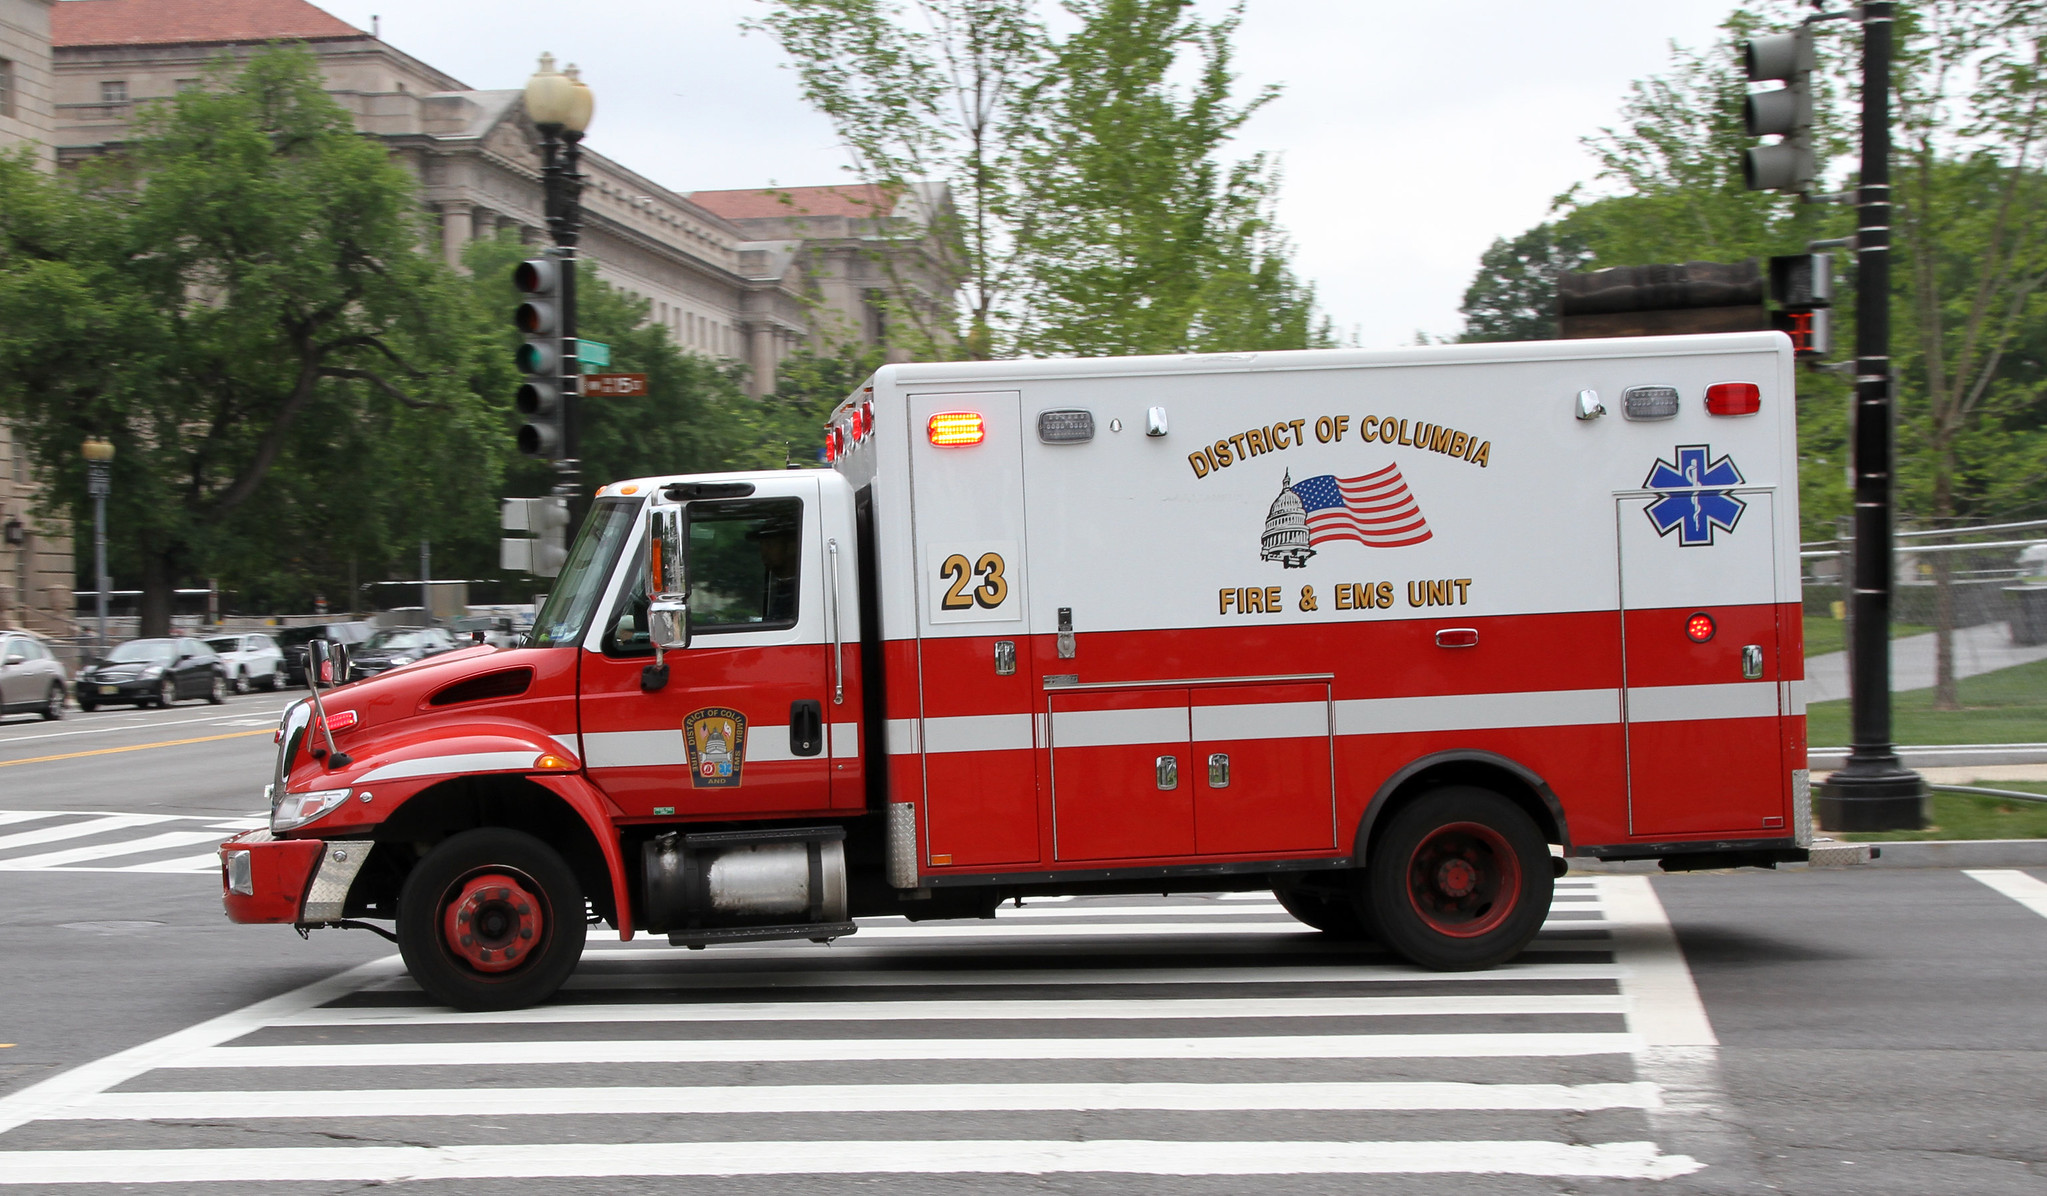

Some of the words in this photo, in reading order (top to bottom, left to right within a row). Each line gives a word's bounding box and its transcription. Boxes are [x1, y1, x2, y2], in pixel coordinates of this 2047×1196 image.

[1188, 418, 1305, 479] DISTRICT
[1315, 415, 1350, 443] OF
[1361, 415, 1491, 467] COLUMBIA
[940, 551, 1008, 611] 23
[1219, 586, 1282, 614] FIRE
[1300, 585, 1318, 612] &
[1334, 581, 1394, 610] EMS
[1408, 578, 1472, 608] UNIT
[687, 711, 705, 745] DISTRICT
[721, 710, 743, 743] COLUMBIA
